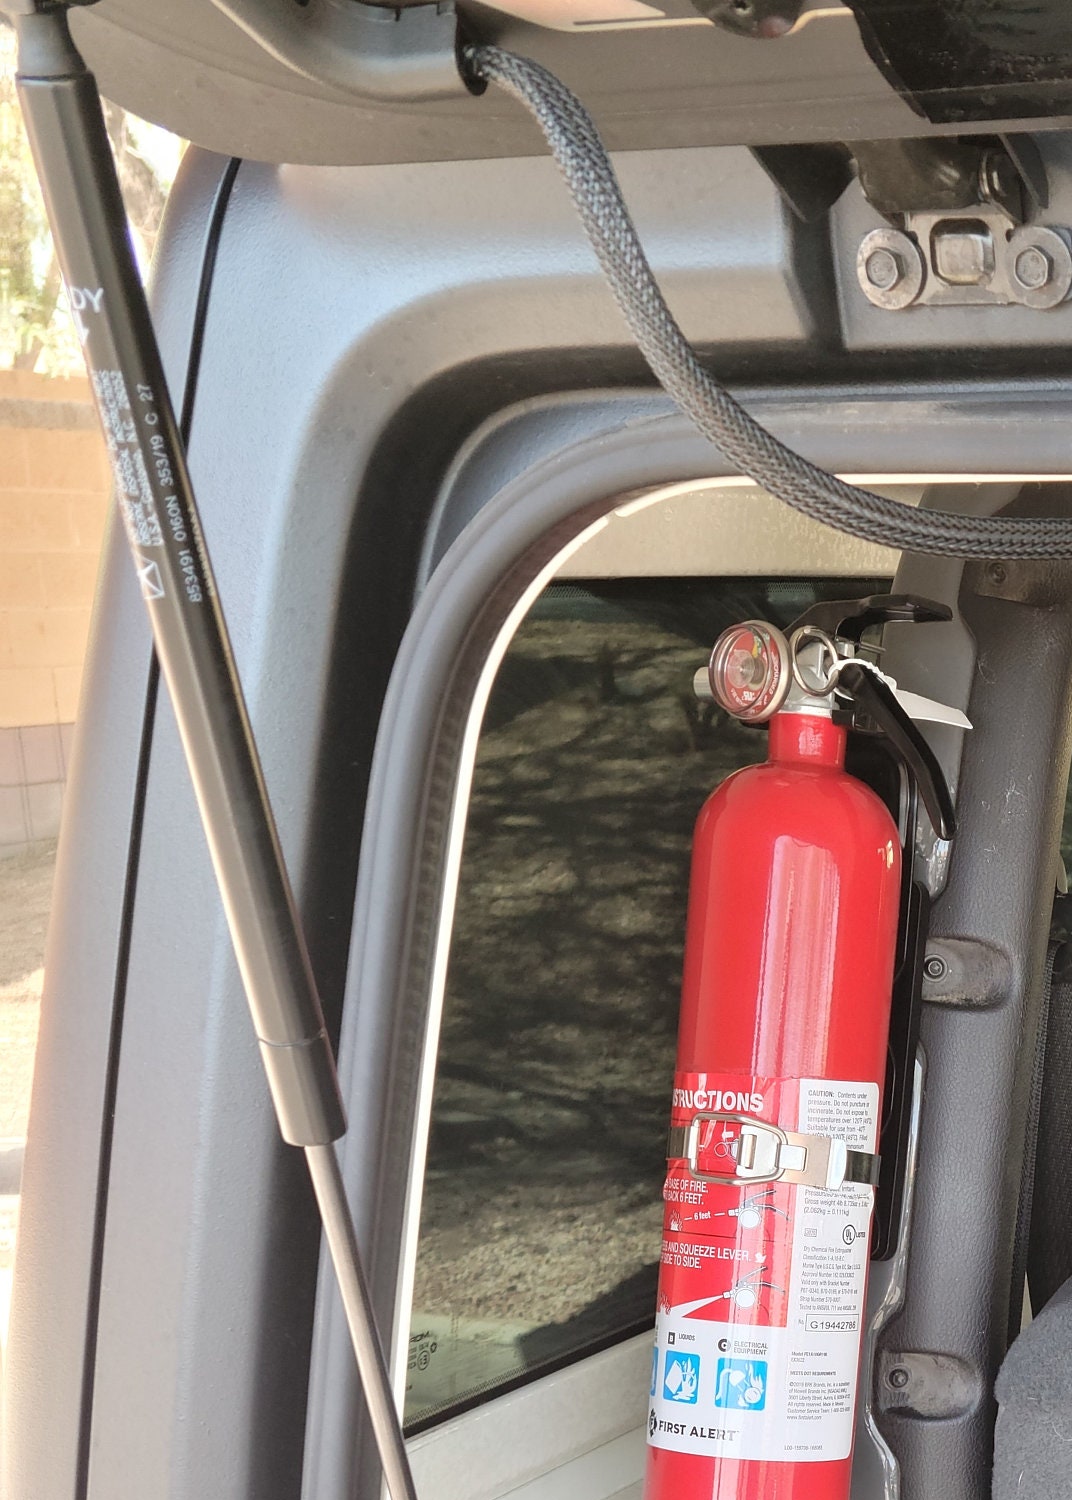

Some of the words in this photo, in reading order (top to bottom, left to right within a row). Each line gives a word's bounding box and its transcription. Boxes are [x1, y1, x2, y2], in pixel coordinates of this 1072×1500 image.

[137, 383, 154, 401] 27
[145, 412, 158, 425] C
[150, 435, 174, 487] 353/19
[179, 549, 202, 602] 853491
[808, 1090, 834, 1098] CAUTION:
[680, 1179, 689, 1191] OF
[690, 1181, 708, 1193] FIRE.
[680, 1192, 684, 1202] 6
[684, 1193, 704, 1205] FEET.
[699, 1211, 711, 1219] feet
[668, 1242, 679, 1253] AND
[680, 1243, 715, 1258] SQUEEZE
[674, 1254, 681, 1266] TO
[683, 1256, 702, 1269] SIDE.
[679, 1333, 695, 1341] LIQUIDS
[734, 1341, 768, 1349] ELECTRICAL
[734, 1348, 767, 1356] EQUIPMENT
[659, 1420, 686, 1435] FIRST
[690, 1426, 737, 1441] ALERT
